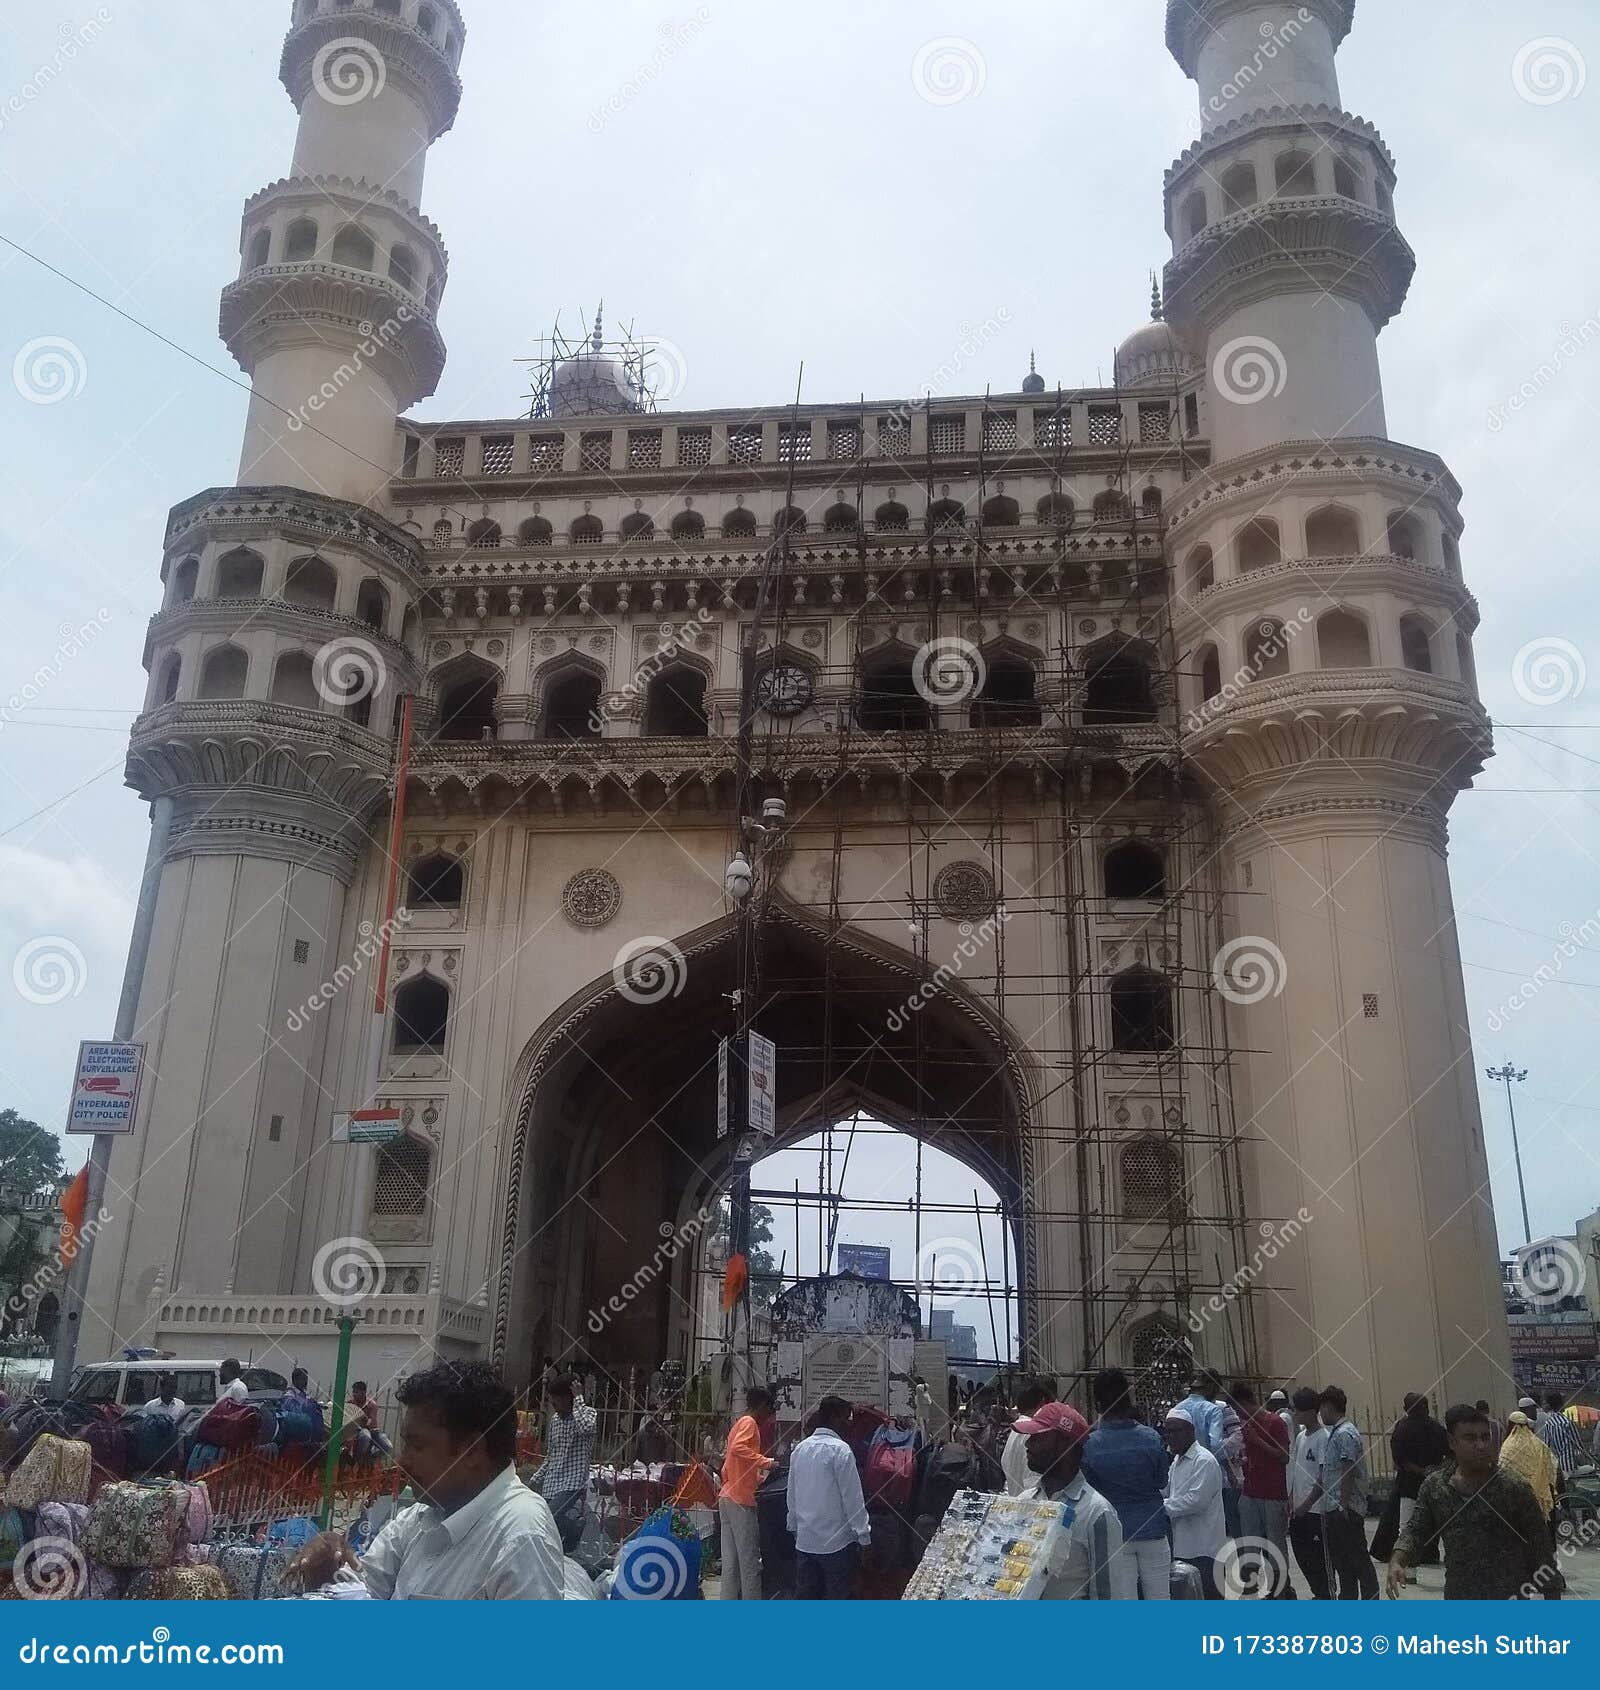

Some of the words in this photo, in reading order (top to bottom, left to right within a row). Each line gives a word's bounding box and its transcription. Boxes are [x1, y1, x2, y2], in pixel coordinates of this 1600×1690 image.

[88, 1047, 109, 1055] AREA
[111, 1047, 137, 1056] UNDER
[87, 1056, 134, 1064] ELECTRONIC
[81, 1065, 138, 1073] SURVEILLANCE
[77, 1100, 131, 1109] HYDERABAD
[74, 1111, 95, 1119] CITY
[96, 1111, 129, 1119] POLICE
[1536, 1364, 1581, 1375] SONA
